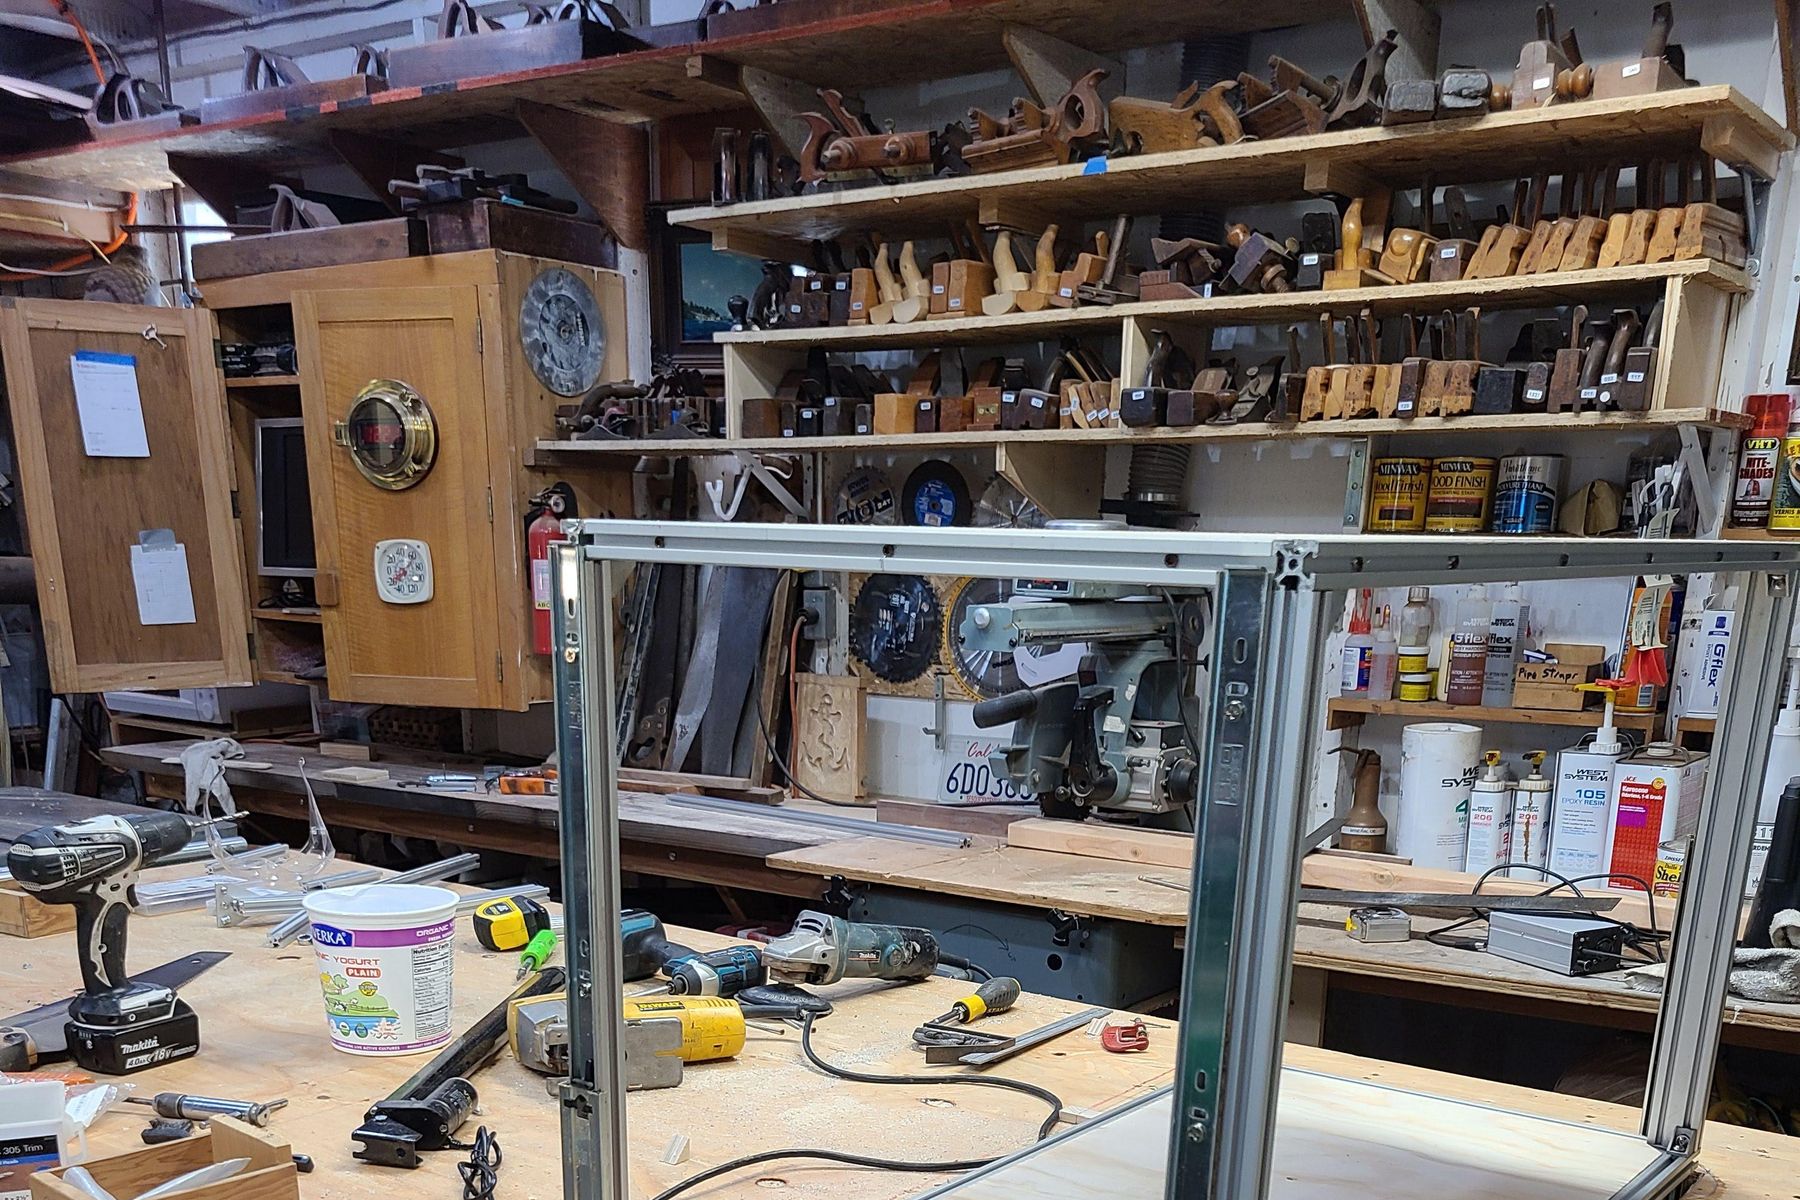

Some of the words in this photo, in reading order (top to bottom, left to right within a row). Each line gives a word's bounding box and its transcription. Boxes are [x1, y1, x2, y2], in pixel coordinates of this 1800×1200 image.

[1747, 440, 1775, 449] VHT
[1440, 462, 1473, 472] MINWAX
[1746, 457, 1770, 468] NITE-
[1380, 463, 1419, 475] MINWAX
[1740, 468, 1774, 479] SHADES
[1432, 476, 1452, 488] OOD
[1454, 476, 1487, 488] FINISH
[1518, 667, 1537, 680] Pipe
[1564, 774, 1609, 782] SYSTEM
[1622, 785, 1649, 793] Kerosene
[1575, 789, 1606, 800] 105
[413, 945, 438, 955] Nutrition
[333, 956, 380, 966] YOGURT
[348, 968, 378, 977] PLAIN
[4, 1146, 21, 1154] 305
[23, 1143, 44, 1152] Trim
